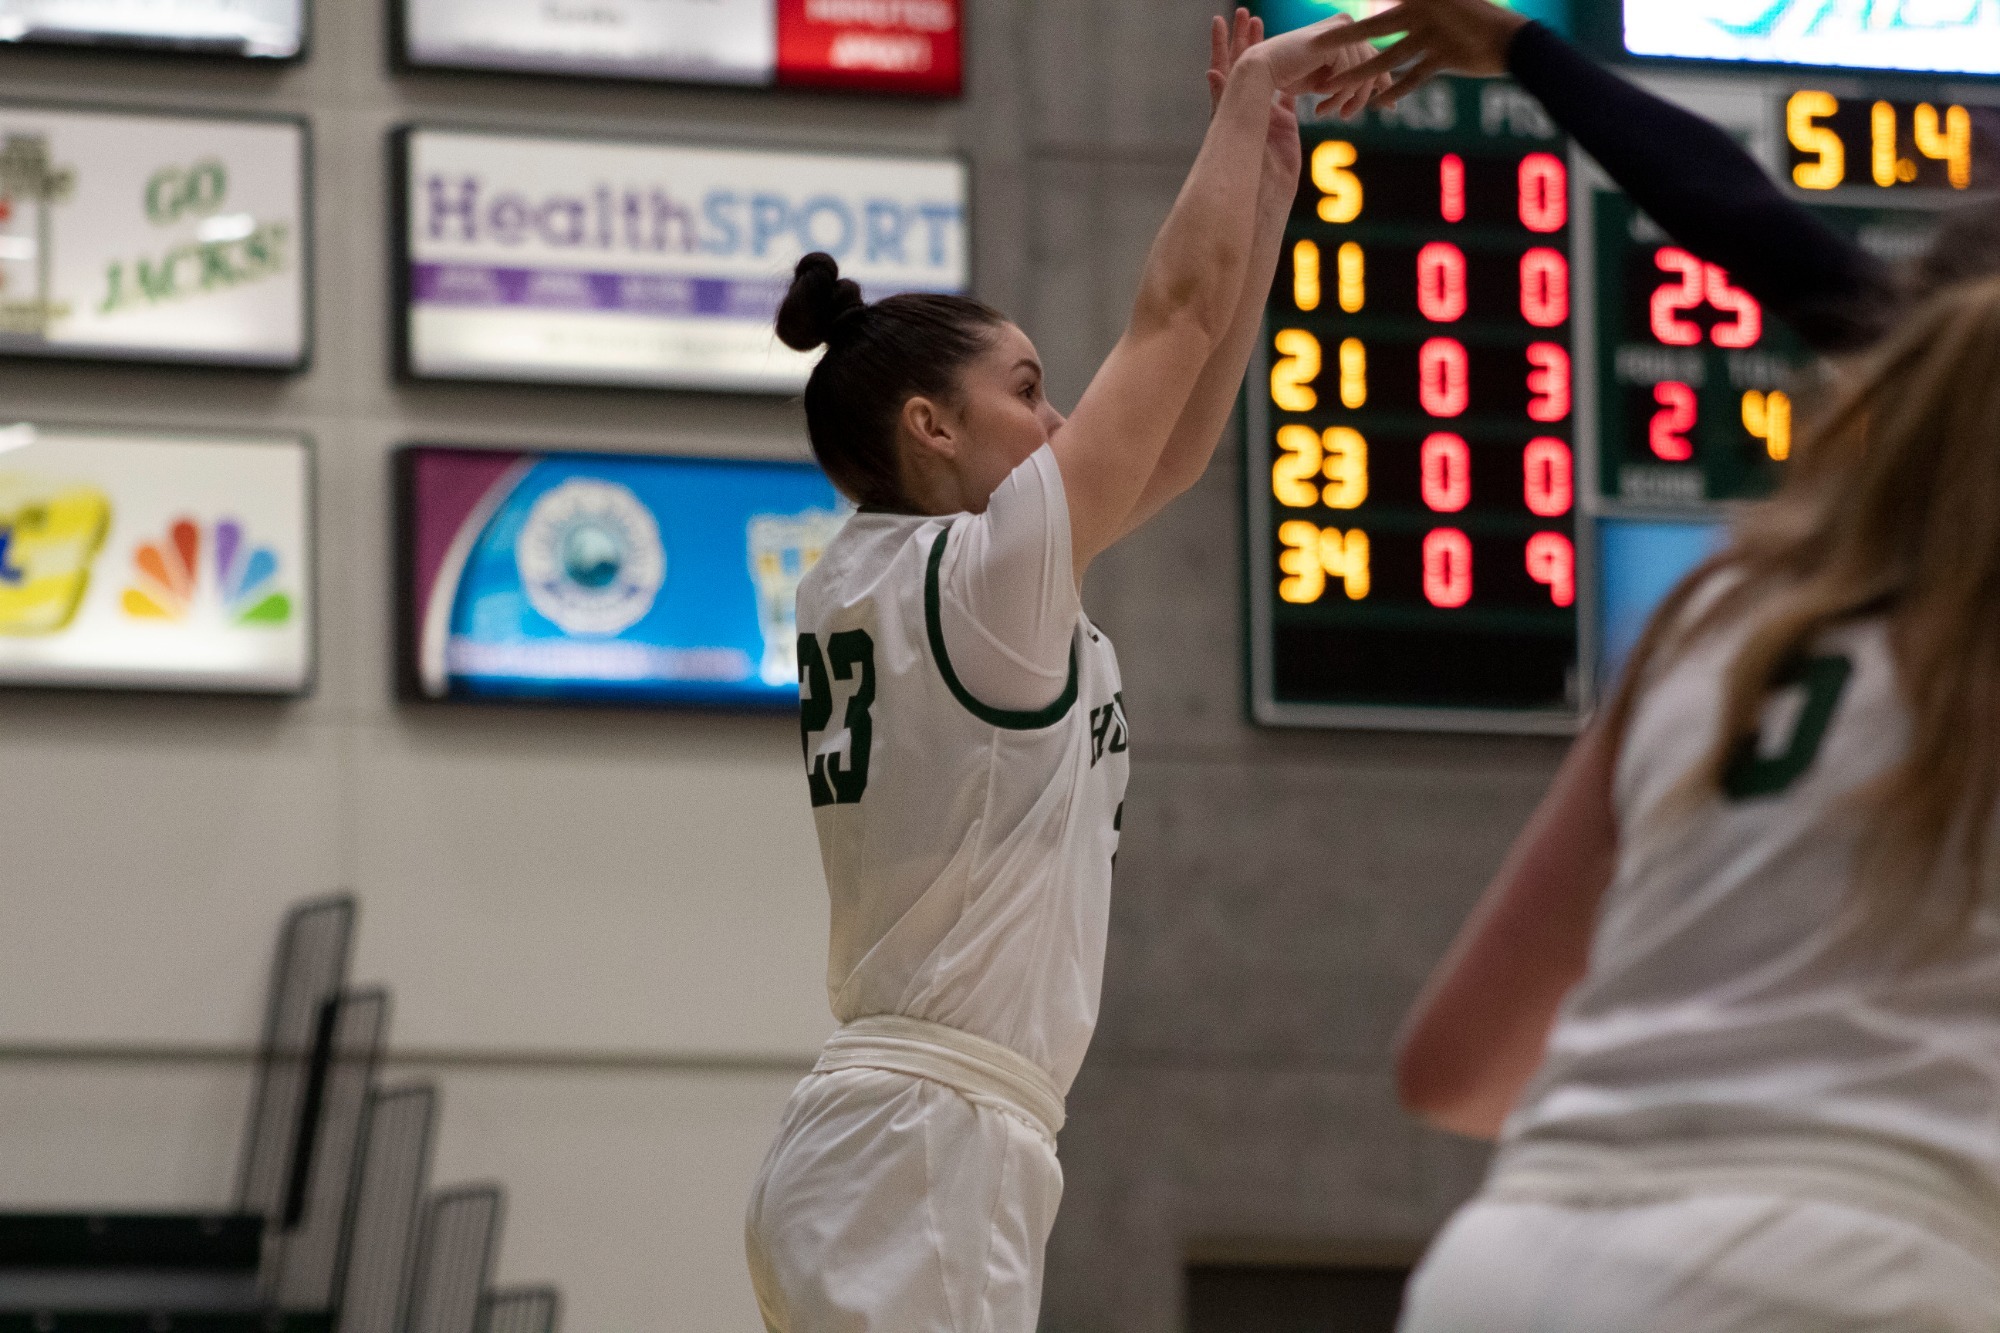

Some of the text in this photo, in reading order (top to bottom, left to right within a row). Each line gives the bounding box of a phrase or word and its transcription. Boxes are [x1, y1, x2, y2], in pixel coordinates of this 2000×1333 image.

[143, 157, 229, 227] GO
[424, 172, 964, 270] HealthSPORT
[1311, 140, 1567, 233] 5 1 0
[1294, 239, 1569, 327] 11 0 0
[1650, 246, 1762, 347] 25
[1271, 329, 1366, 412] 21
[1419, 336, 1469, 417] 0
[1526, 341, 1571, 422] 3
[1650, 381, 1697, 461] 2
[1272, 424, 1573, 517] 23 0 0
[1278, 520, 1575, 608] 34 0 9
[797, 628, 875, 807] 23
